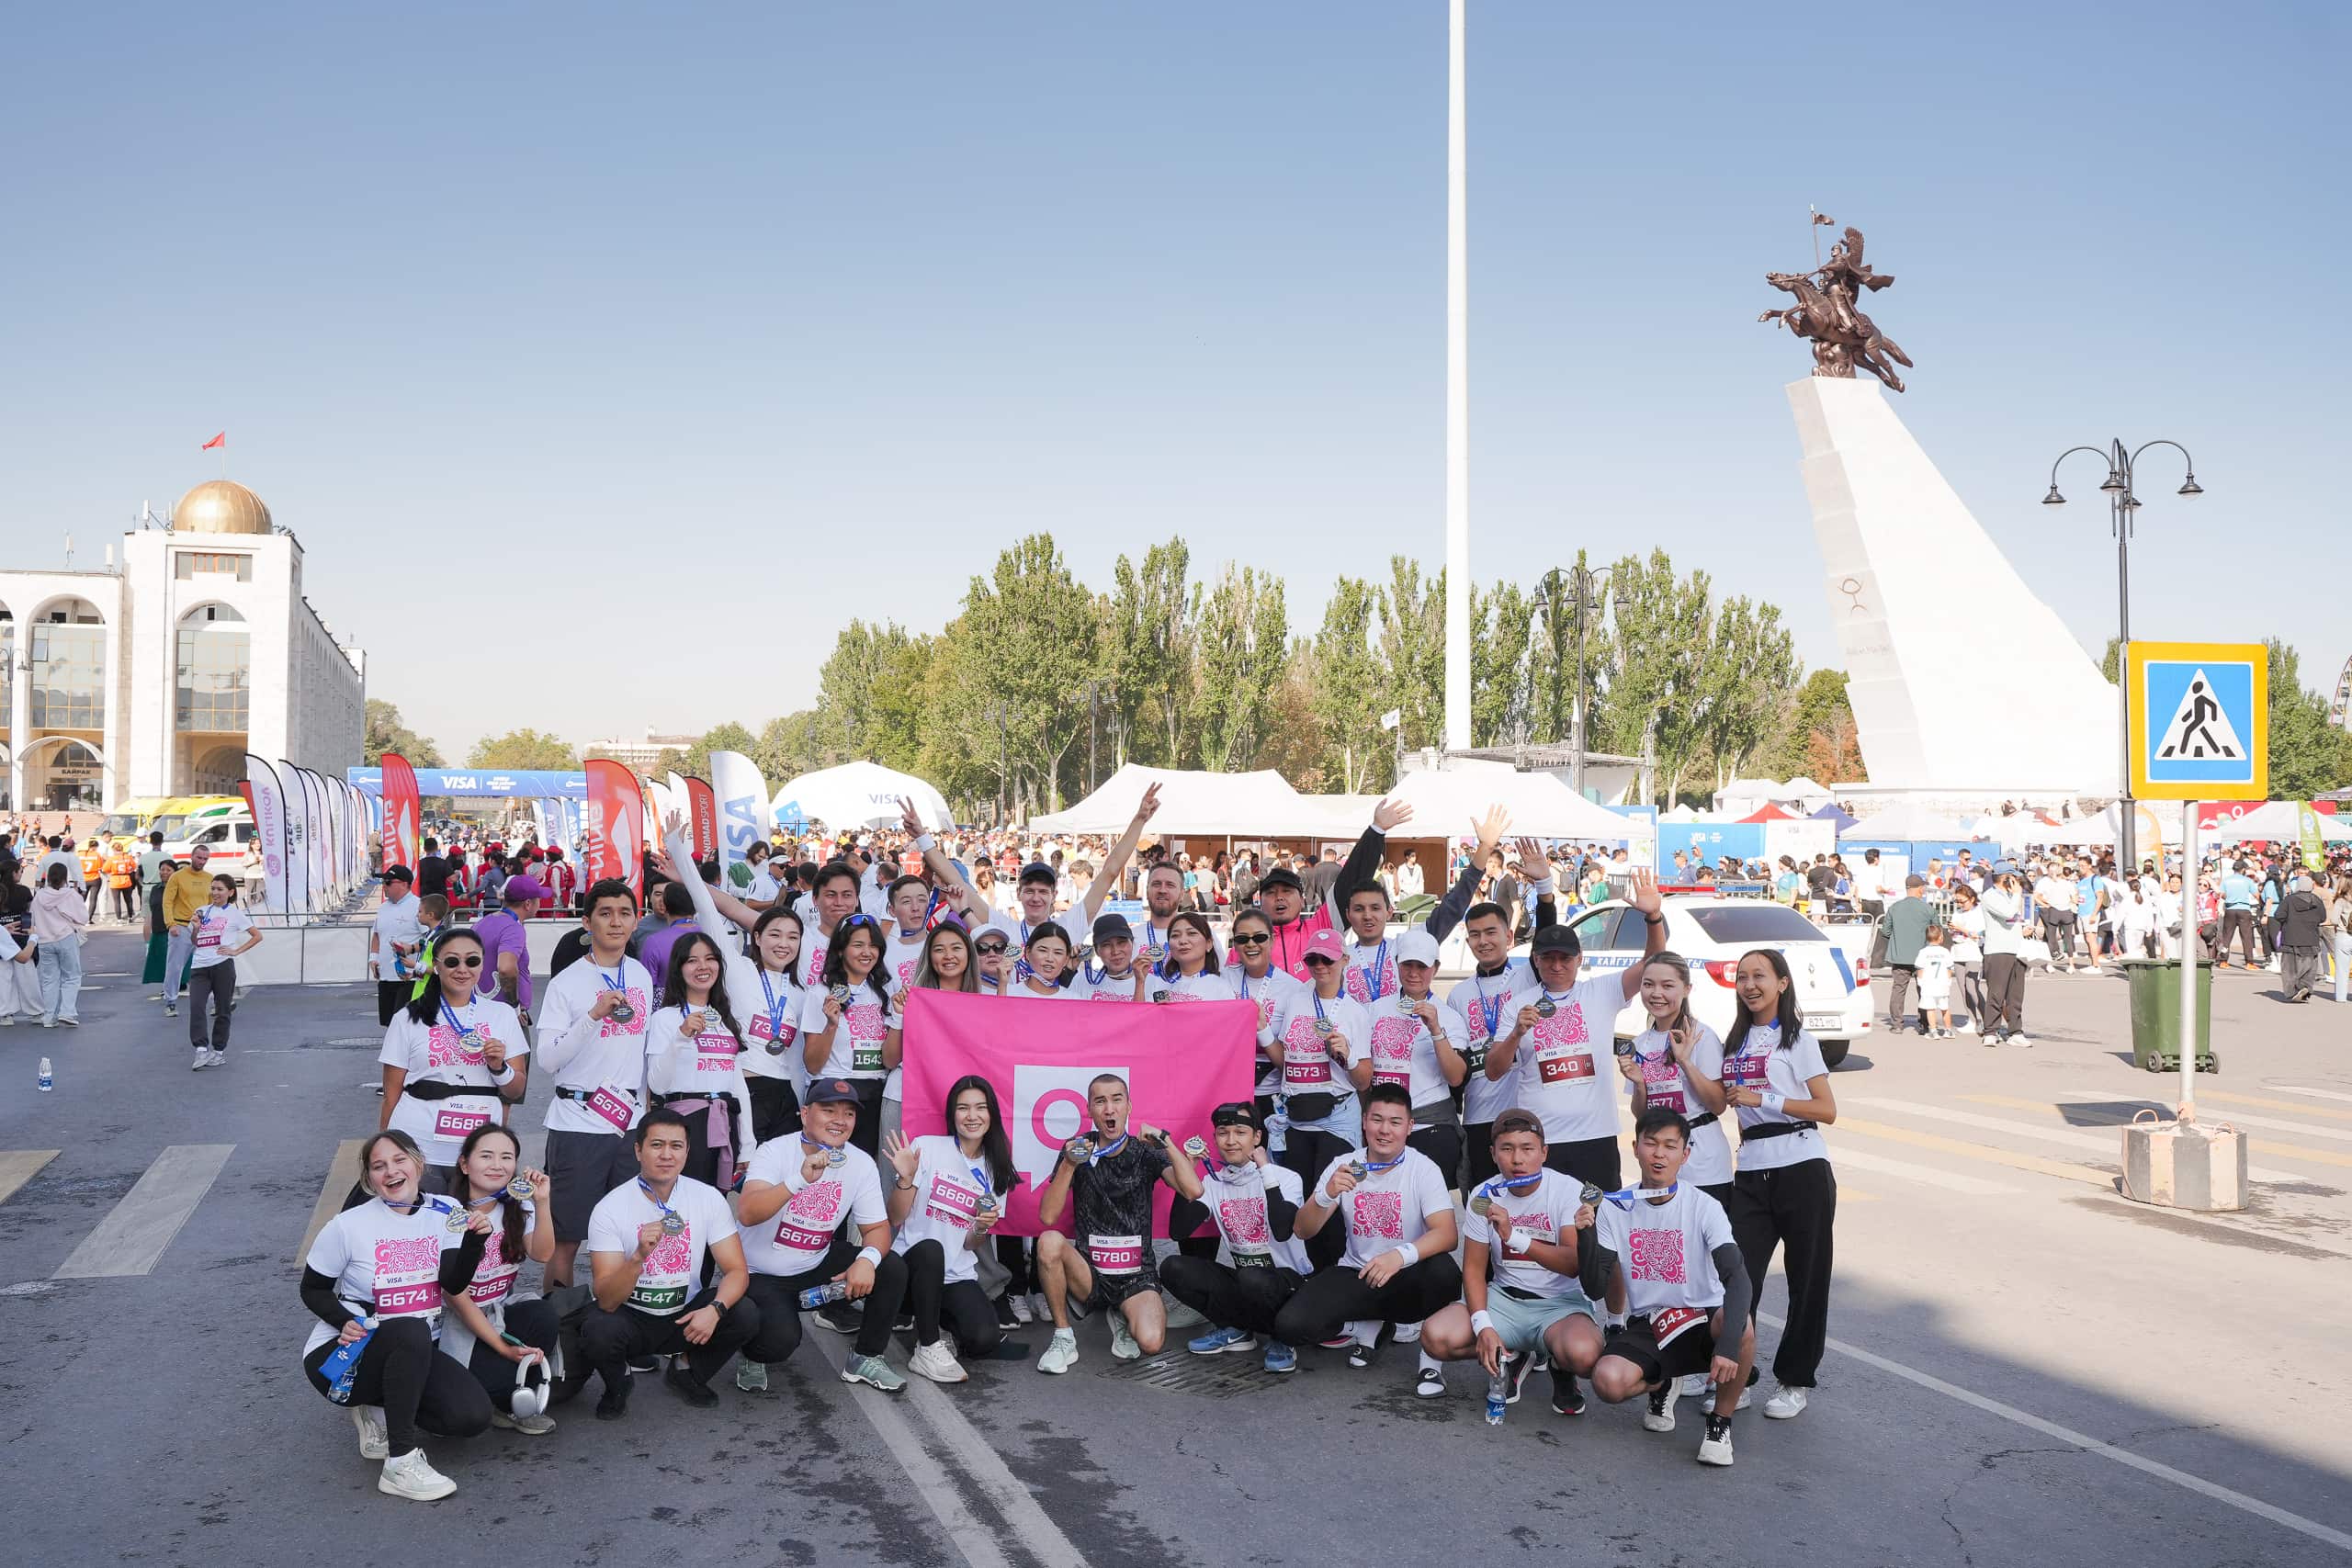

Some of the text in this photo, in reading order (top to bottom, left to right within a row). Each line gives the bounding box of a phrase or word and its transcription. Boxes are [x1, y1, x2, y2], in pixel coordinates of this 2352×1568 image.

[441, 775, 477, 790] VISA
[868, 794, 900, 804] VISA
[725, 795, 759, 869] ISA
[754, 1019, 788, 1040] 736
[698, 1037, 730, 1048] 6675
[1470, 1054, 1485, 1066] 17
[1546, 1060, 1578, 1077] 340
[1286, 1065, 1320, 1077] 6673
[593, 1094, 628, 1122] 6679
[935, 1184, 976, 1209] 6680
[779, 1228, 822, 1246] 6676
[1091, 1250, 1130, 1263] 6780
[379, 1288, 429, 1307] 6674
[630, 1291, 675, 1303] 1647
[1657, 1309, 1689, 1333] 341
